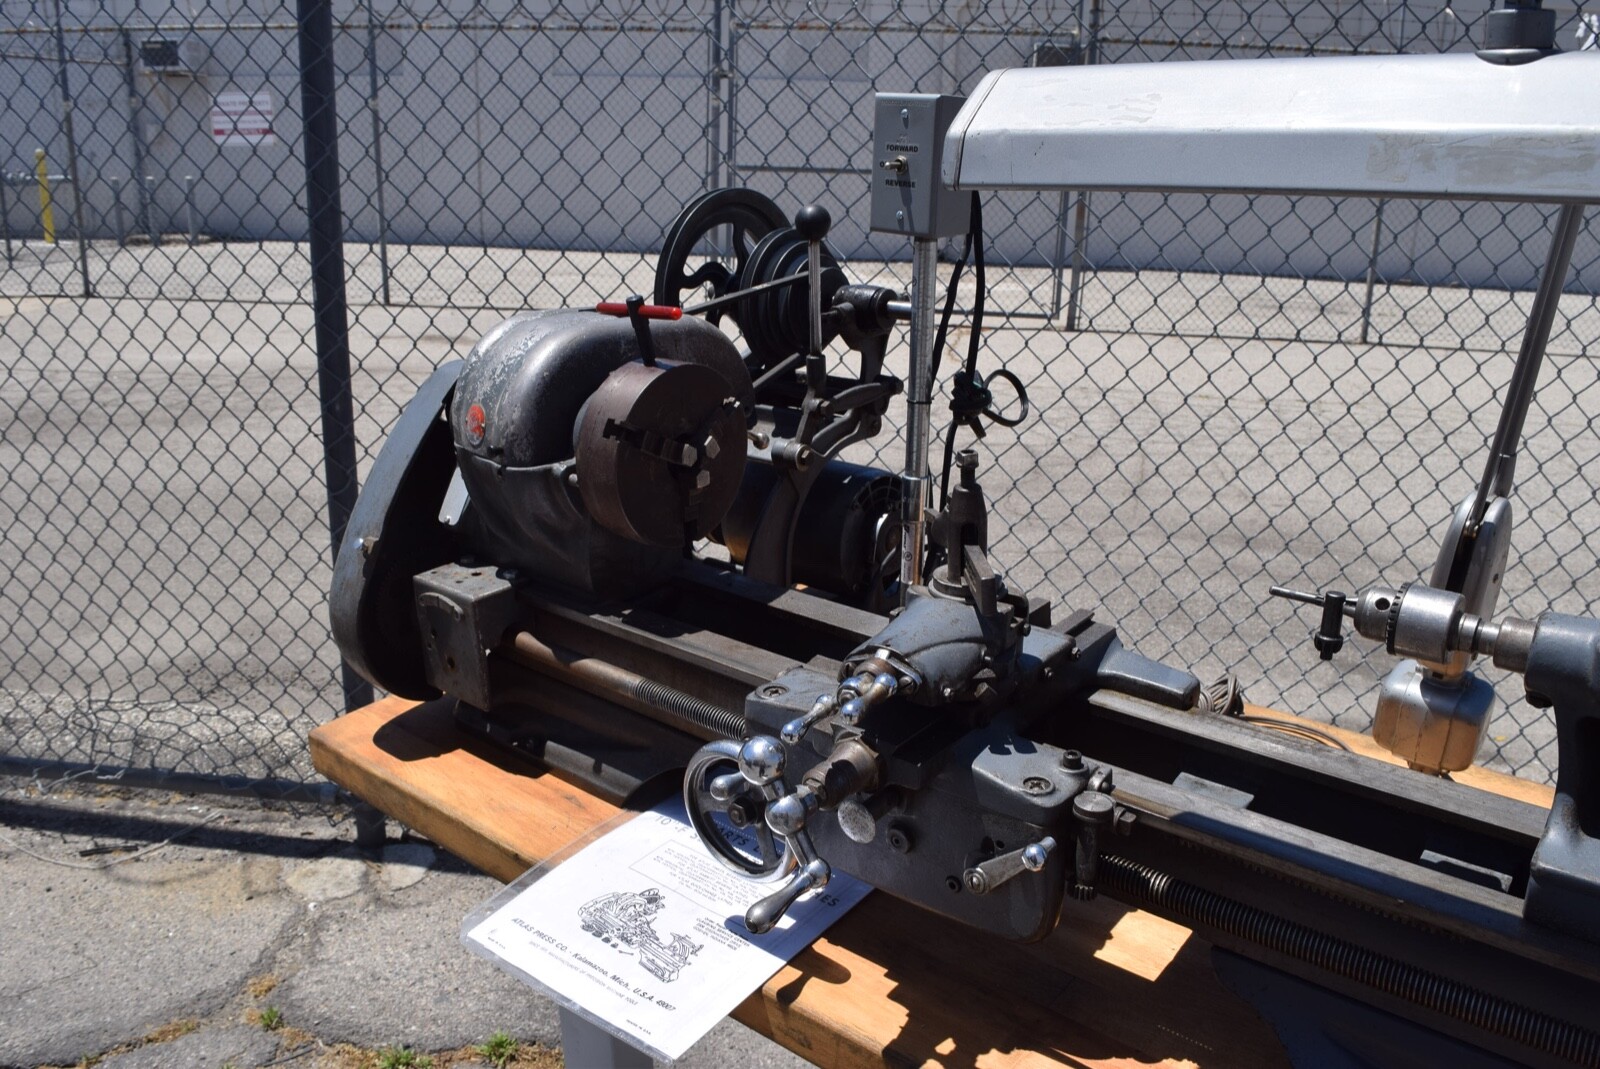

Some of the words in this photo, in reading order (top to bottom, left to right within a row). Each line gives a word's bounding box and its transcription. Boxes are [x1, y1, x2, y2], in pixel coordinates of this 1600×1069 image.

[886, 144, 919, 153] FORWARD
[885, 179, 916, 189] REVERSE
[715, 824, 749, 847] ARTS
[511, 917, 535, 932] ATLAS
[532, 929, 557, 944] PRESS
